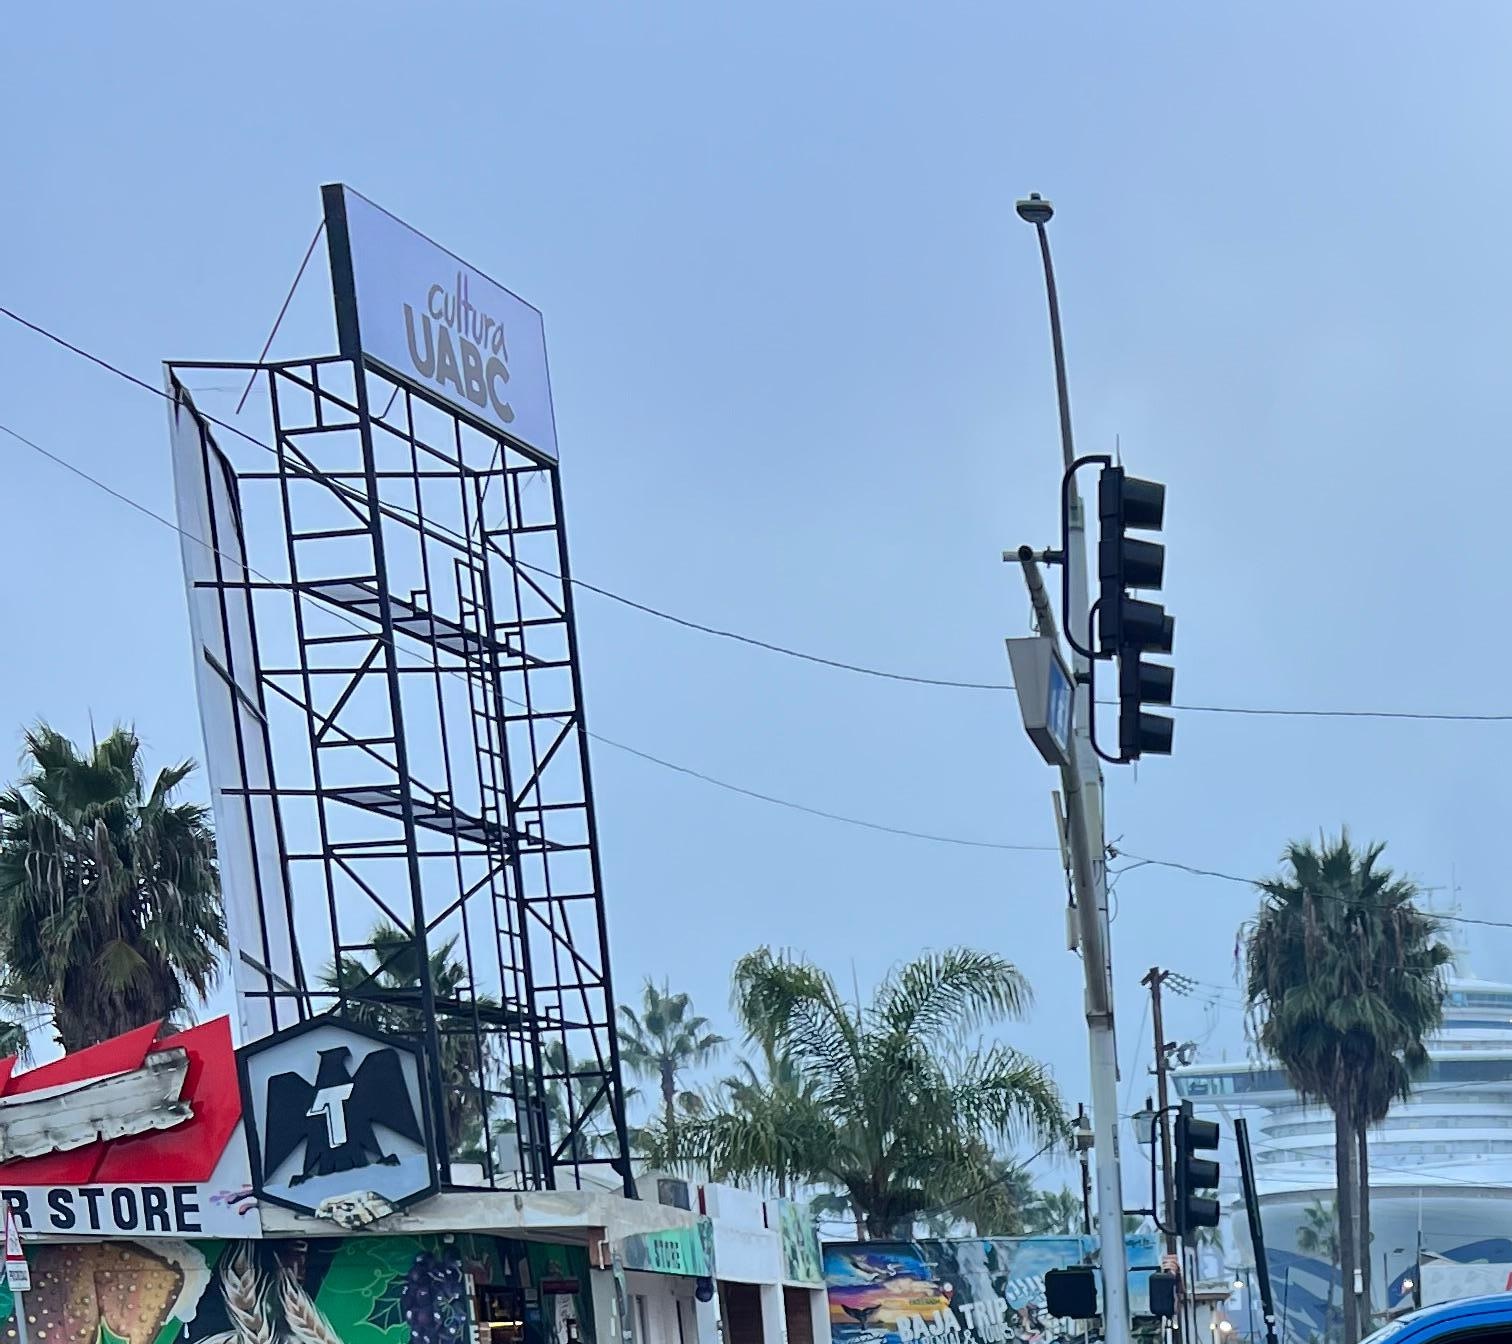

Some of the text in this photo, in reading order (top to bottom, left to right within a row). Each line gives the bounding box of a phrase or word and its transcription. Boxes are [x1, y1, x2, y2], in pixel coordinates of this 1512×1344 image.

[428, 270, 508, 362] cultura
[404, 303, 515, 423] UABC
[47, 1186, 202, 1232] STORE
[896, 1306, 962, 1342] BAJA
